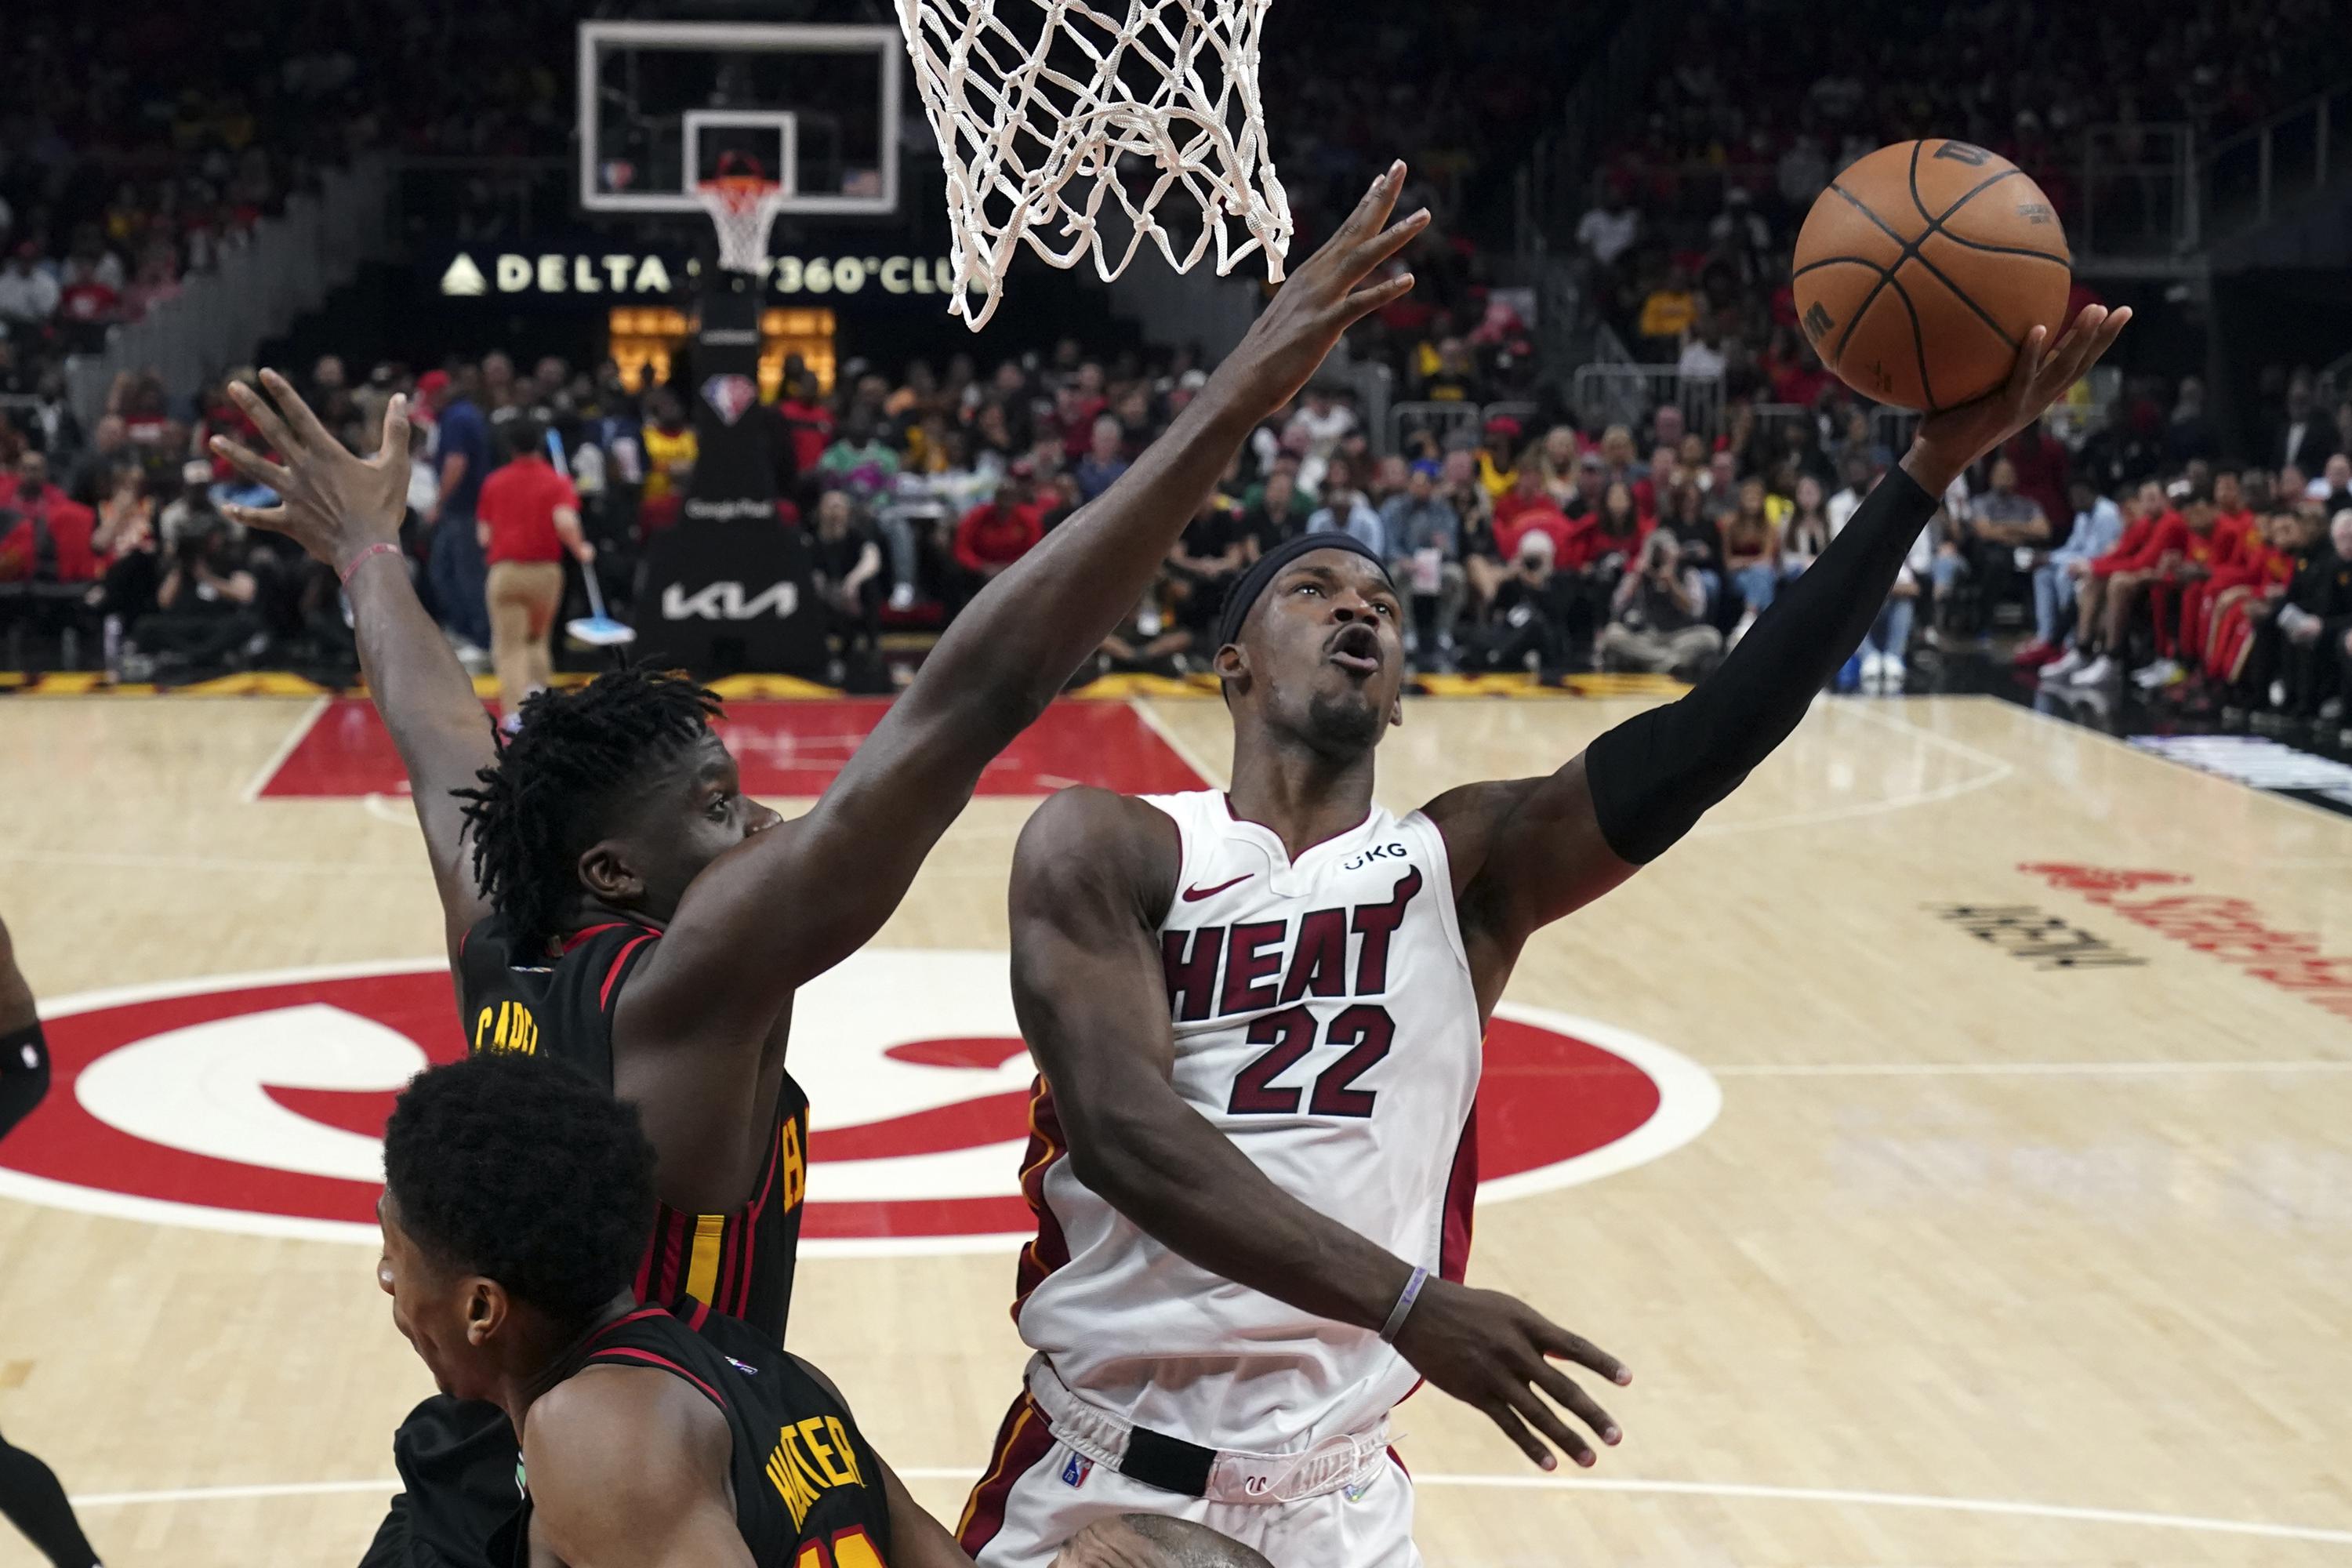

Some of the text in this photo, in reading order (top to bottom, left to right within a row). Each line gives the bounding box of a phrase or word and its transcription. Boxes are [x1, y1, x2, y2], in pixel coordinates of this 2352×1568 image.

[495, 253, 673, 292] DELTA
[1162, 863, 1423, 1022] HEAT
[1226, 1004, 1396, 1119] 22
